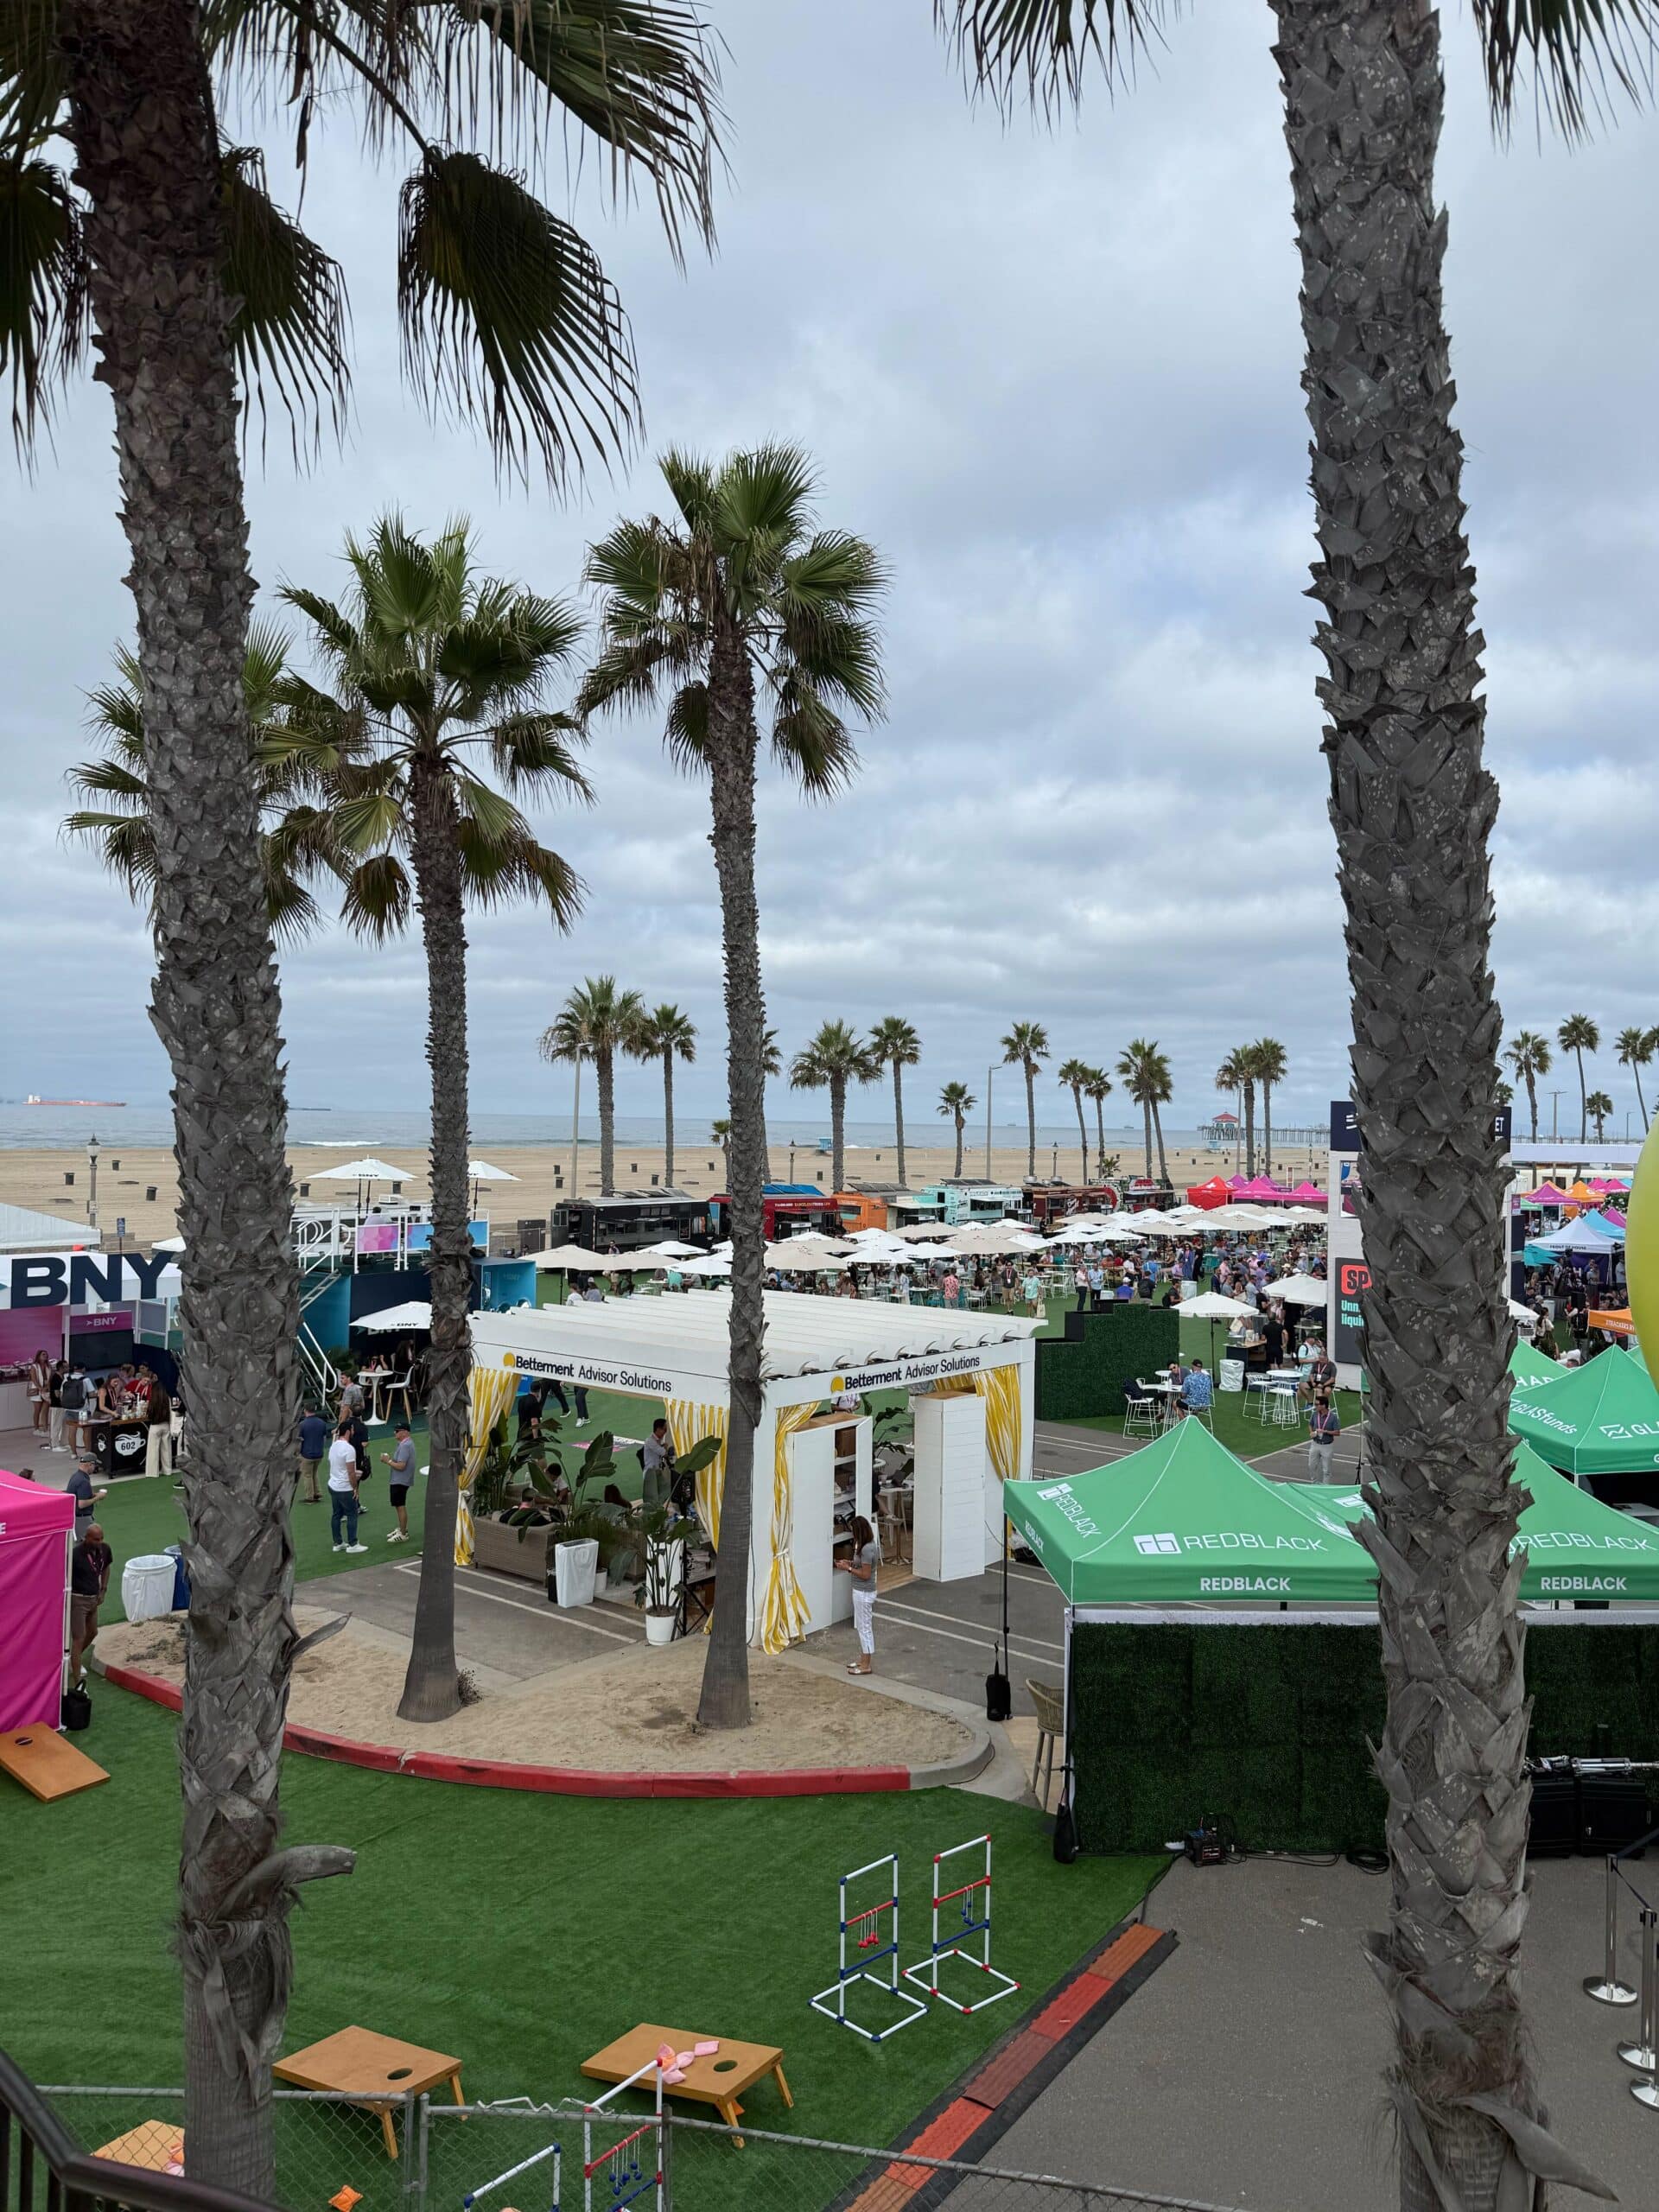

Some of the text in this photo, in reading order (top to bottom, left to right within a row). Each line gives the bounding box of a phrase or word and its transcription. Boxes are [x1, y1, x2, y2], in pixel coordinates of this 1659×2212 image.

[11, 1251, 175, 1309] BNY
[93, 1317, 117, 1326] BNY
[516, 1356, 672, 1392] Betterment Advisor Solutions
[845, 1356, 980, 1389] Betterment Advisor Solutions
[1512, 1403, 1578, 1434] GLASfunds
[121, 1441, 136, 1451] 602
[1052, 1493, 1103, 1538] REDBLACK
[1183, 1533, 1328, 1552] REDBLACK
[1516, 1532, 1659, 1551] REDBLACK
[1200, 1577, 1291, 1591] REDBLACK
[1541, 1577, 1627, 1590] REDBLACK
